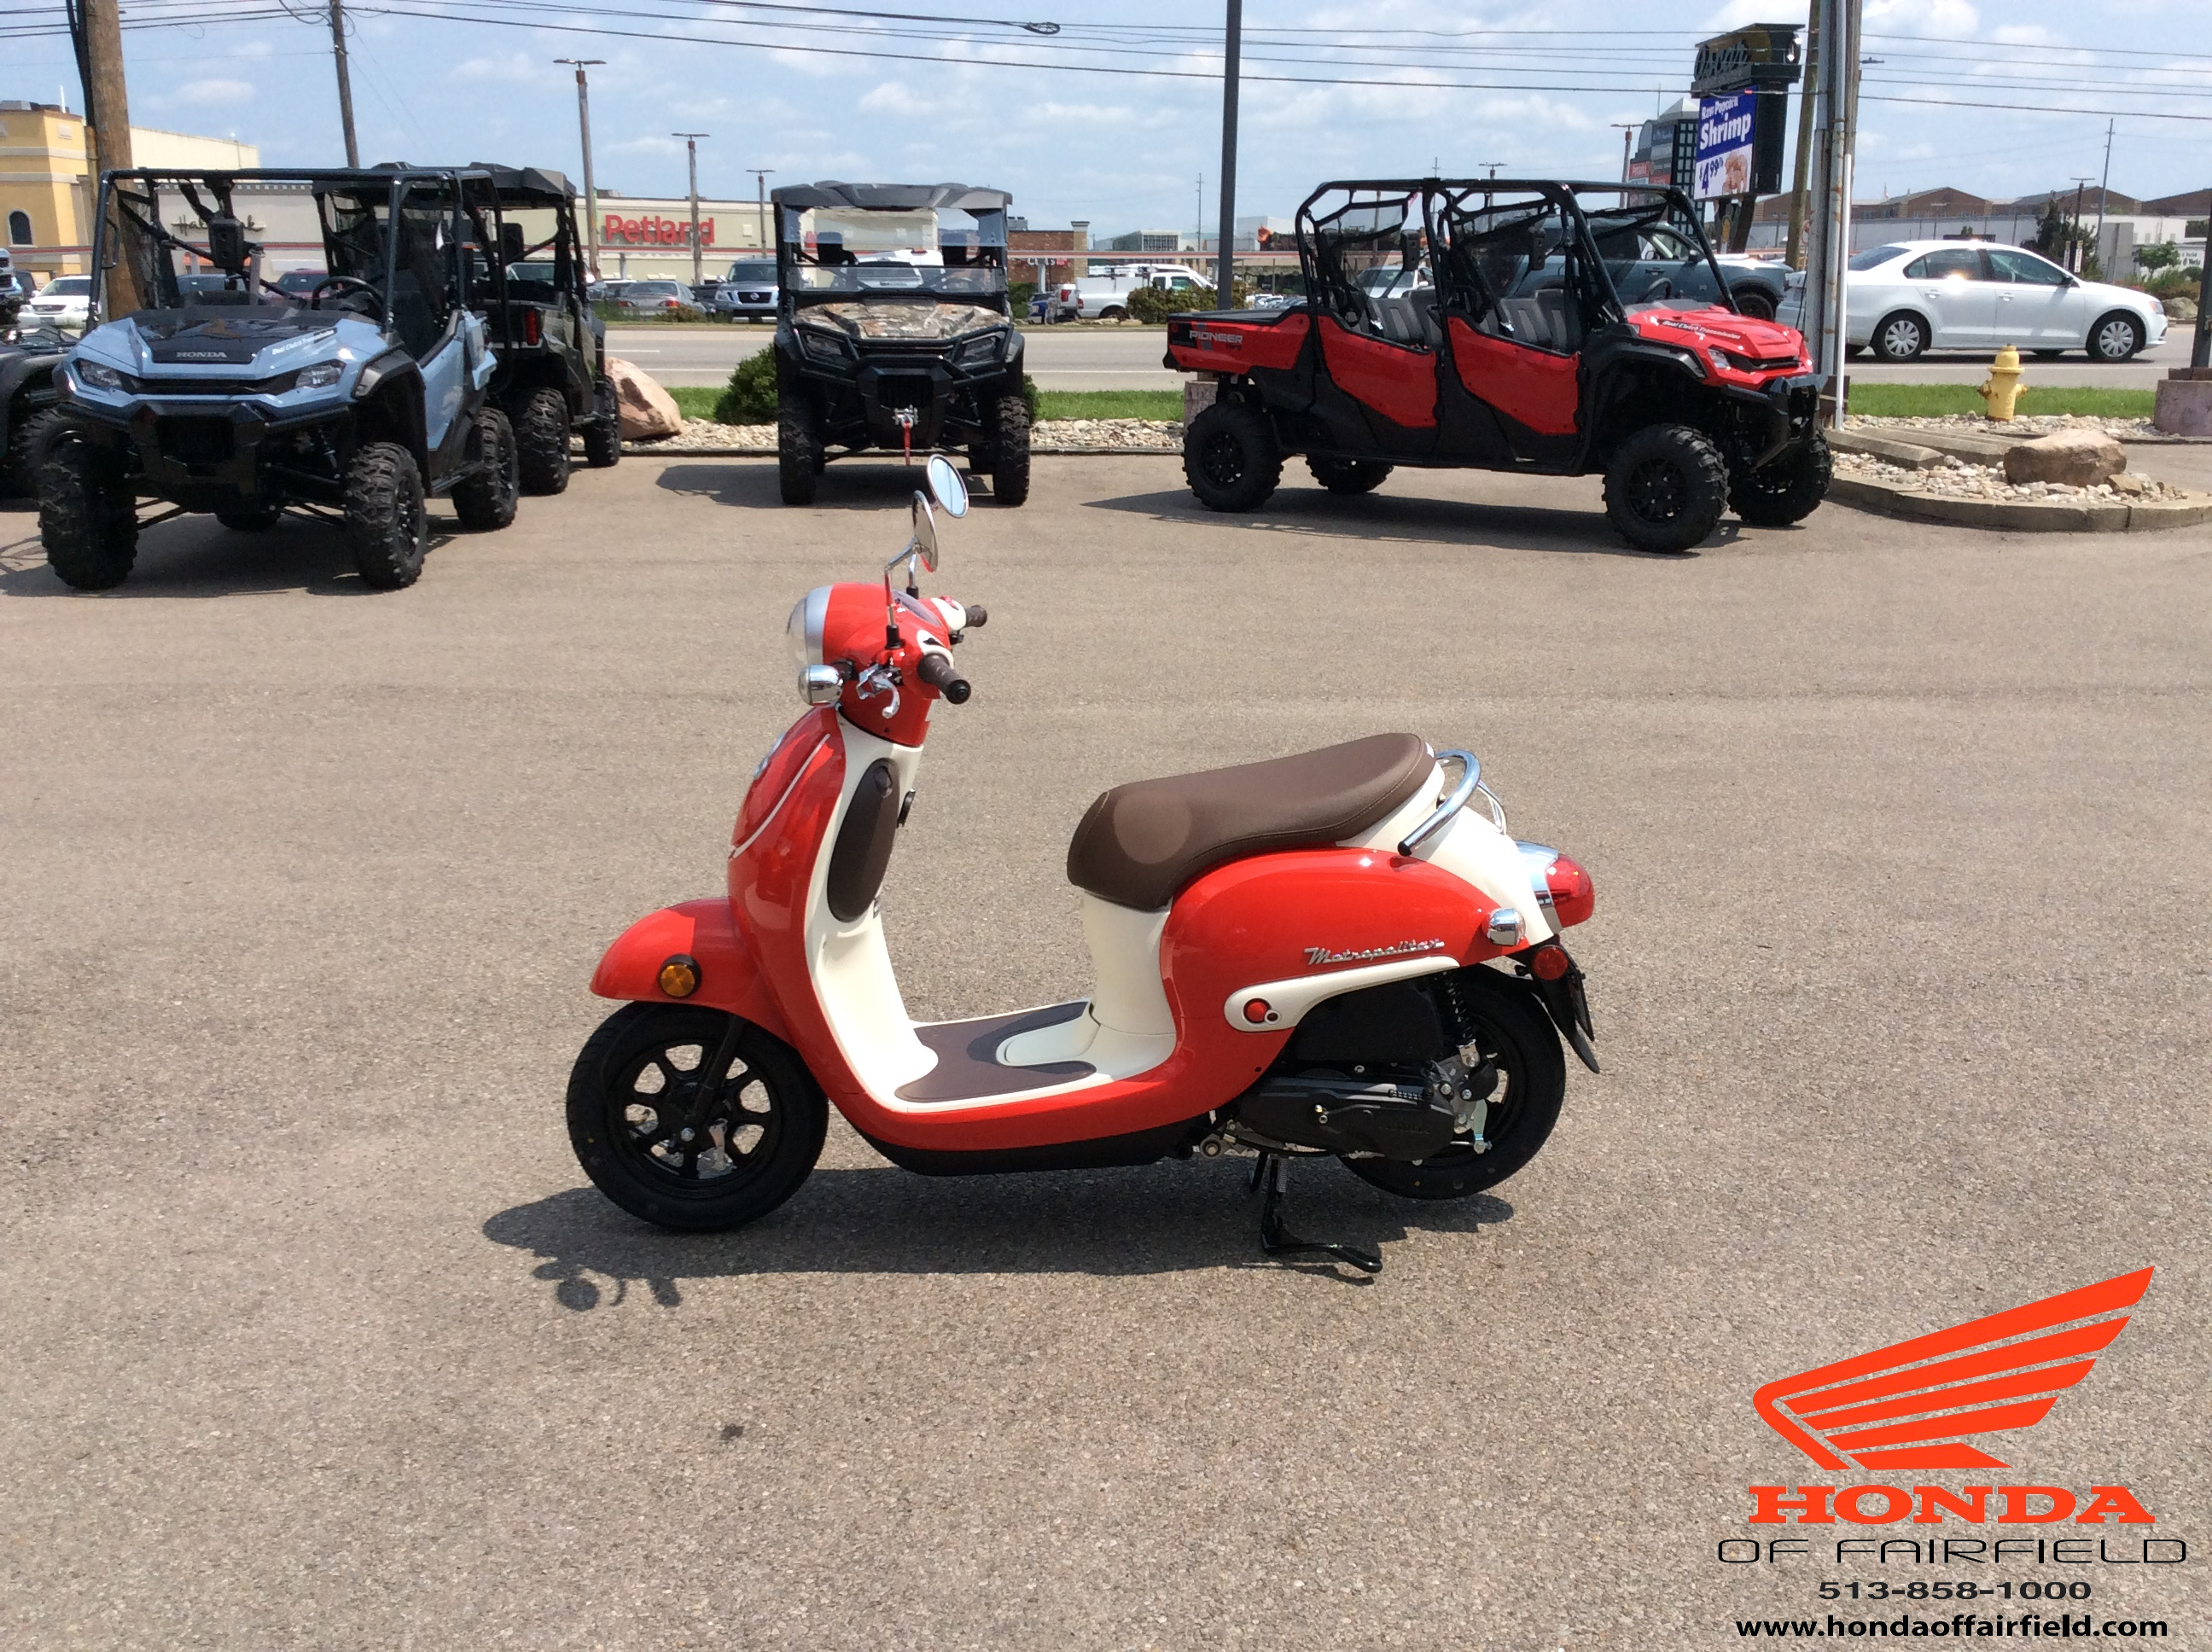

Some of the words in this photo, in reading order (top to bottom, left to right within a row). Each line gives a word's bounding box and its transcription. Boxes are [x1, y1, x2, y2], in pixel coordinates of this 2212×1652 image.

[1699, 113, 1752, 150] Shrimp
[605, 214, 715, 244] Petland
[1189, 330, 1243, 344] PIONEER
[1699, 325, 1742, 340] Transmission
[1303, 939, 1445, 966] Metropolitan
